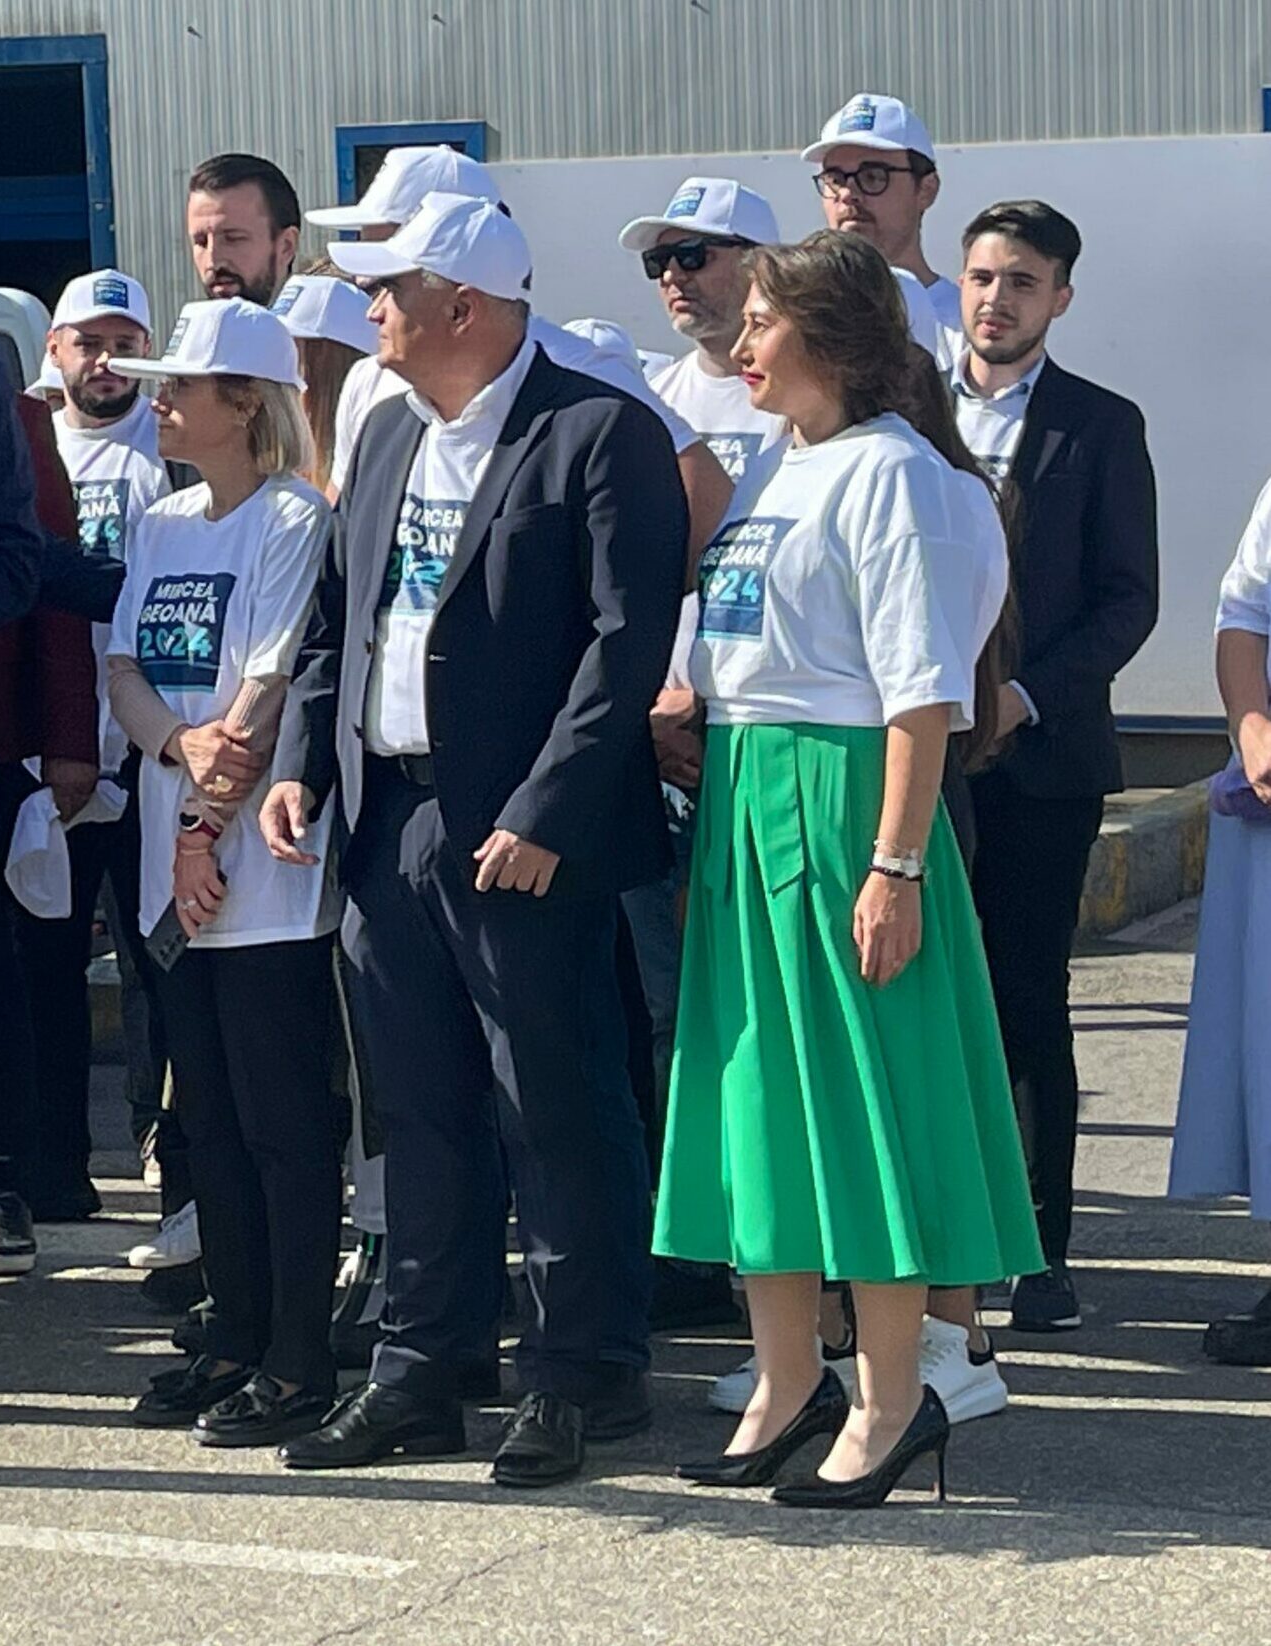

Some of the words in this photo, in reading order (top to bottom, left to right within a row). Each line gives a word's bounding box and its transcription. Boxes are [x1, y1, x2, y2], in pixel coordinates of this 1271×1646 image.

[72, 484, 115, 501] CEA
[77, 494, 121, 520] ANĂ
[388, 551, 448, 584] 202
[154, 580, 216, 600] MIRCEA
[140, 596, 219, 624] GEOANĂ
[139, 626, 213, 659] 2024
